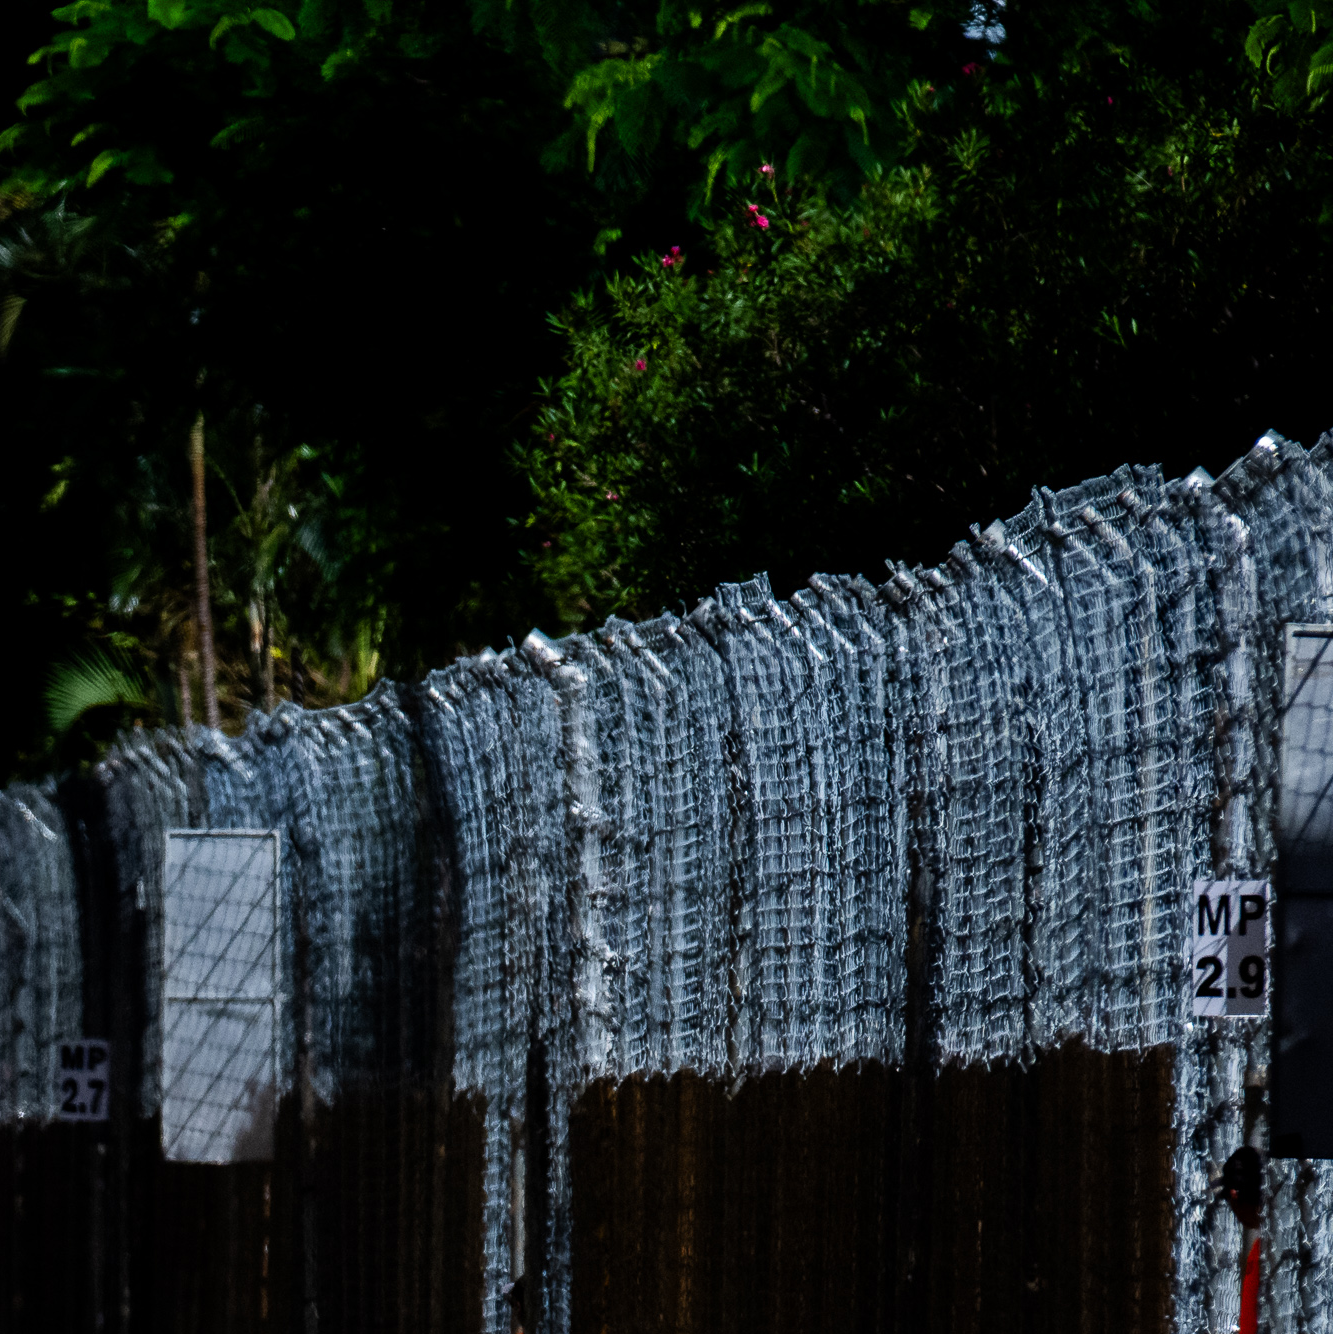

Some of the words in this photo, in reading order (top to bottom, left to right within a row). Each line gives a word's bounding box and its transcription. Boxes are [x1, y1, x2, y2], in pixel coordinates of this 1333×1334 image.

[1197, 894, 1265, 936] MP
[1195, 955, 1265, 998] 2.9
[61, 1044, 107, 1070] MP
[61, 1077, 105, 1113] 2.7
